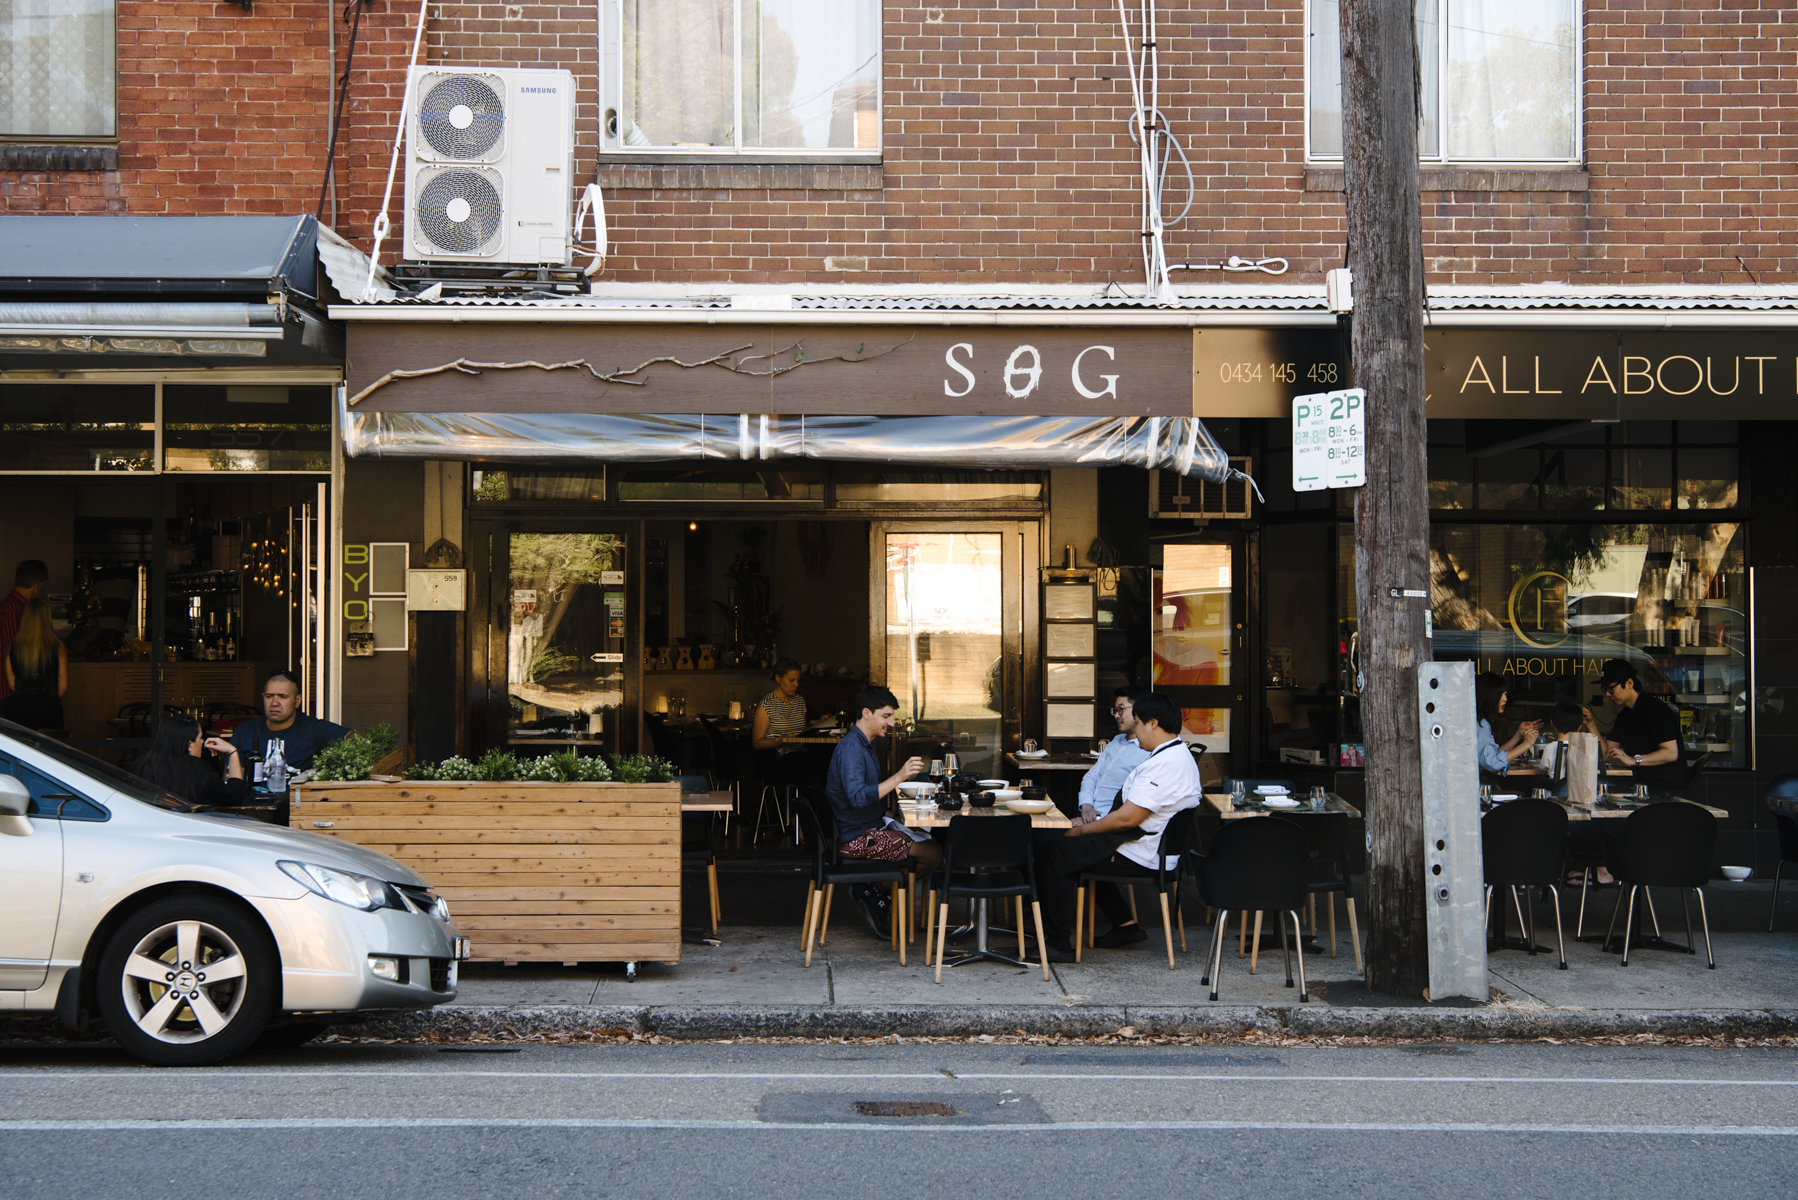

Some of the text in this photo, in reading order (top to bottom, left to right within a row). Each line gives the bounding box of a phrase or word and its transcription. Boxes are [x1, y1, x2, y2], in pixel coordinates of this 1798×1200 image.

[1220, 362, 1338, 383] 0434 145 458
[1459, 355, 1562, 394] ALL
[1580, 355, 1778, 396] ABOUT
[1298, 405, 1322, 427] P 15
[1330, 396, 1360, 420] 2P
[210, 427, 287, 446] 557
[514, 603, 536, 611] 2017
[1467, 658, 1613, 675] LL ABOUT HAI
